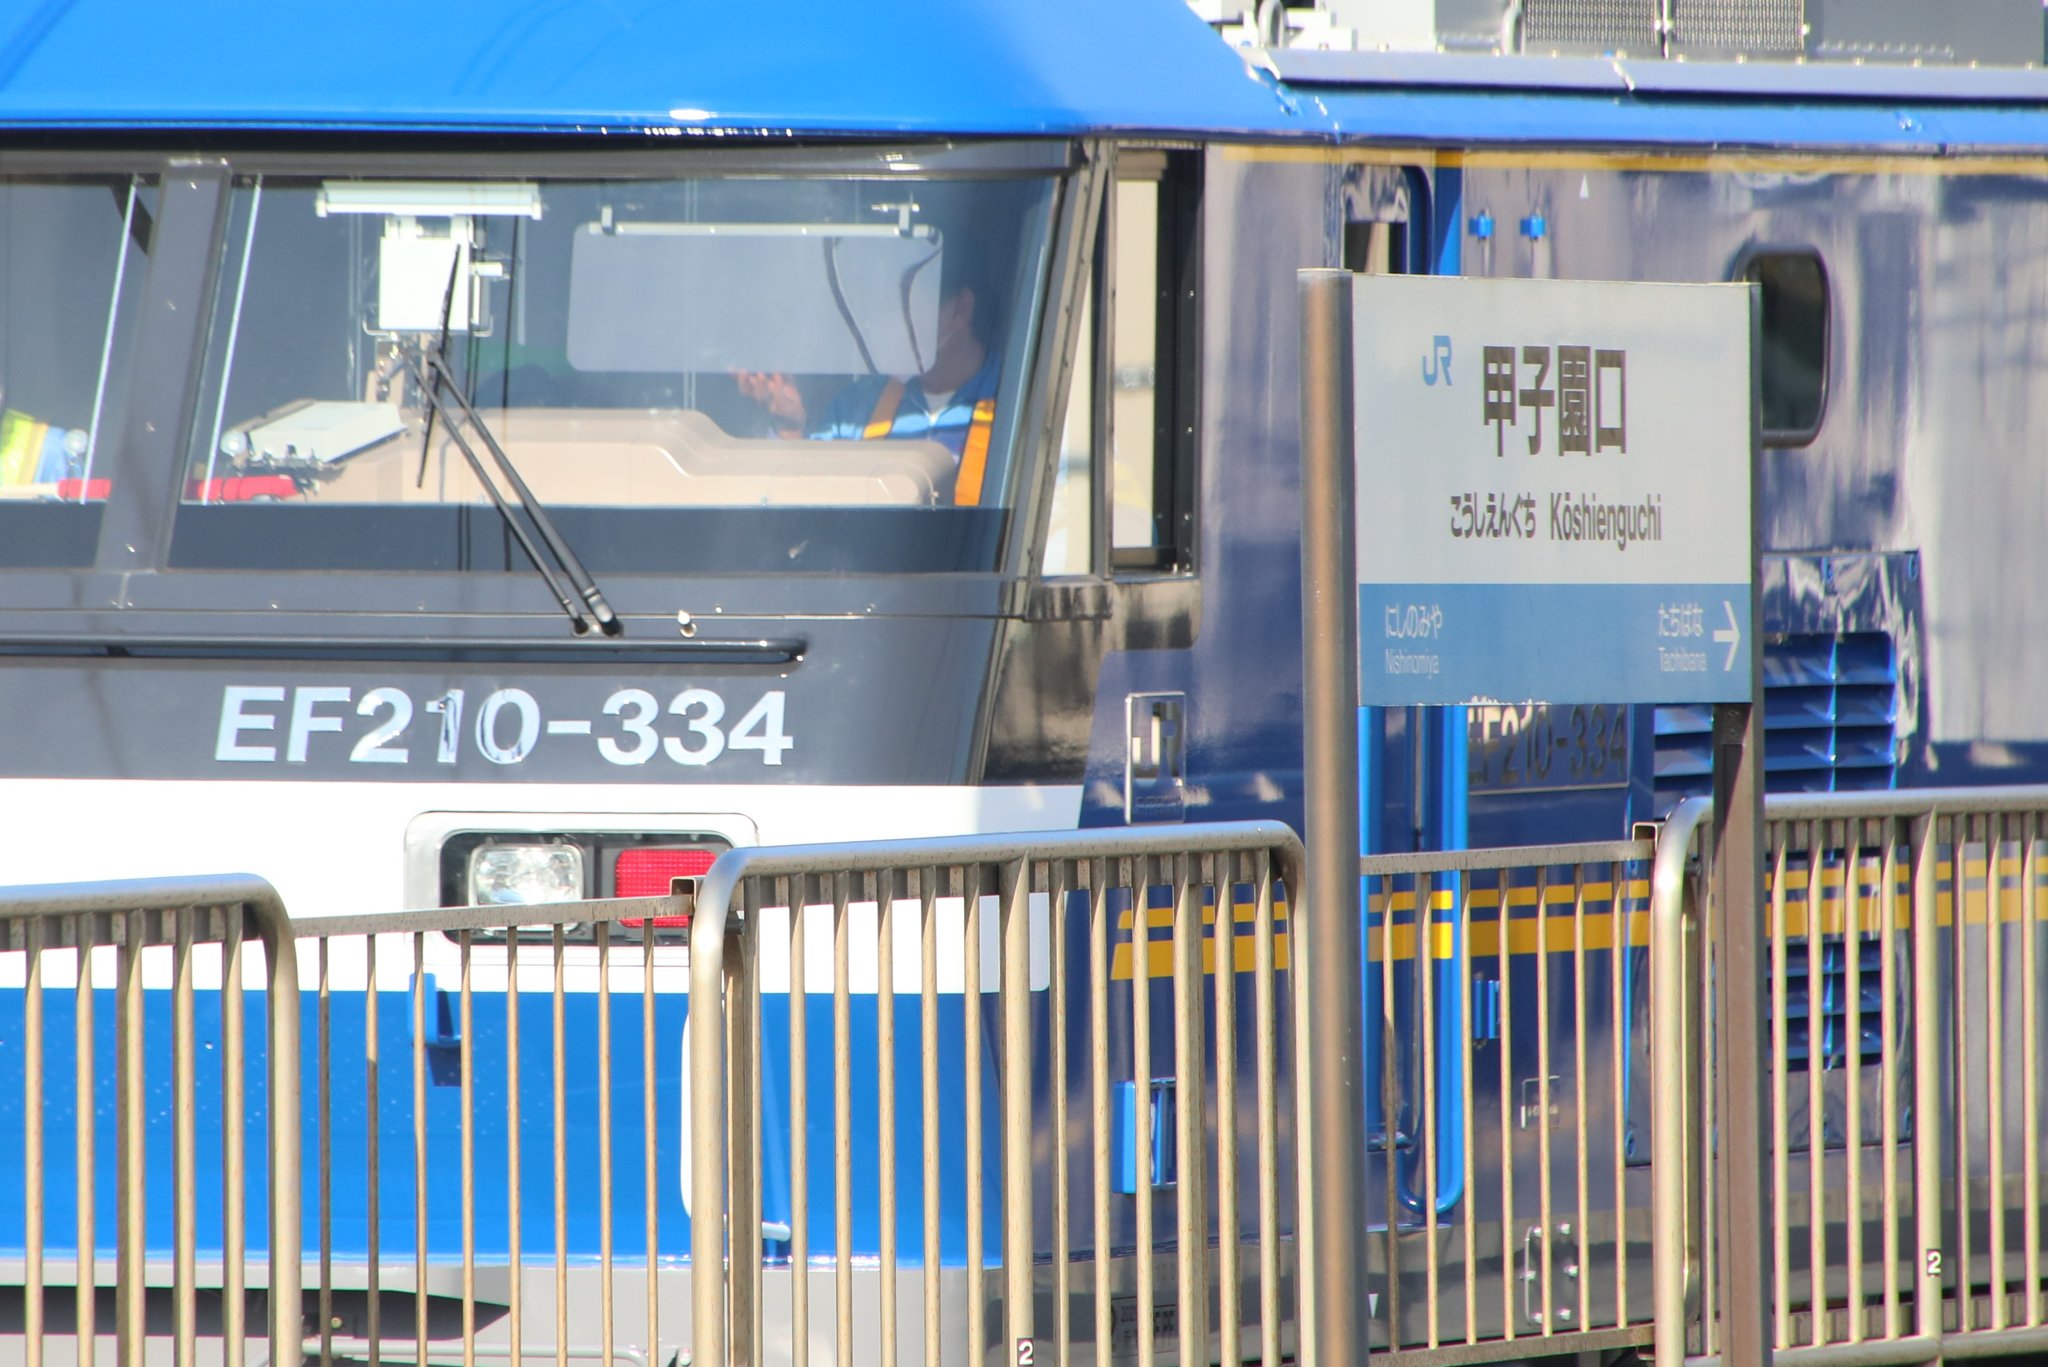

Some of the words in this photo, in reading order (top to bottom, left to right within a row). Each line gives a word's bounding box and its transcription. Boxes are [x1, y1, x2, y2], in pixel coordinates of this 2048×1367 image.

[1422, 334, 1453, 386] JR
[1483, 345, 1627, 457] 甲子園口
[1450, 492, 1536, 539] こうしえんぐち
[1550, 492, 1662, 551] Kōshienguchi
[1385, 604, 1443, 639] にしのみや
[1658, 603, 1704, 637] たちばな
[1385, 648, 1440, 679] Nishinomiya
[1658, 647, 1707, 672] Tachibana
[214, 685, 795, 766] EF210-334
[1927, 1250, 1942, 1274] 2
[1018, 1339, 1034, 1366] 2
